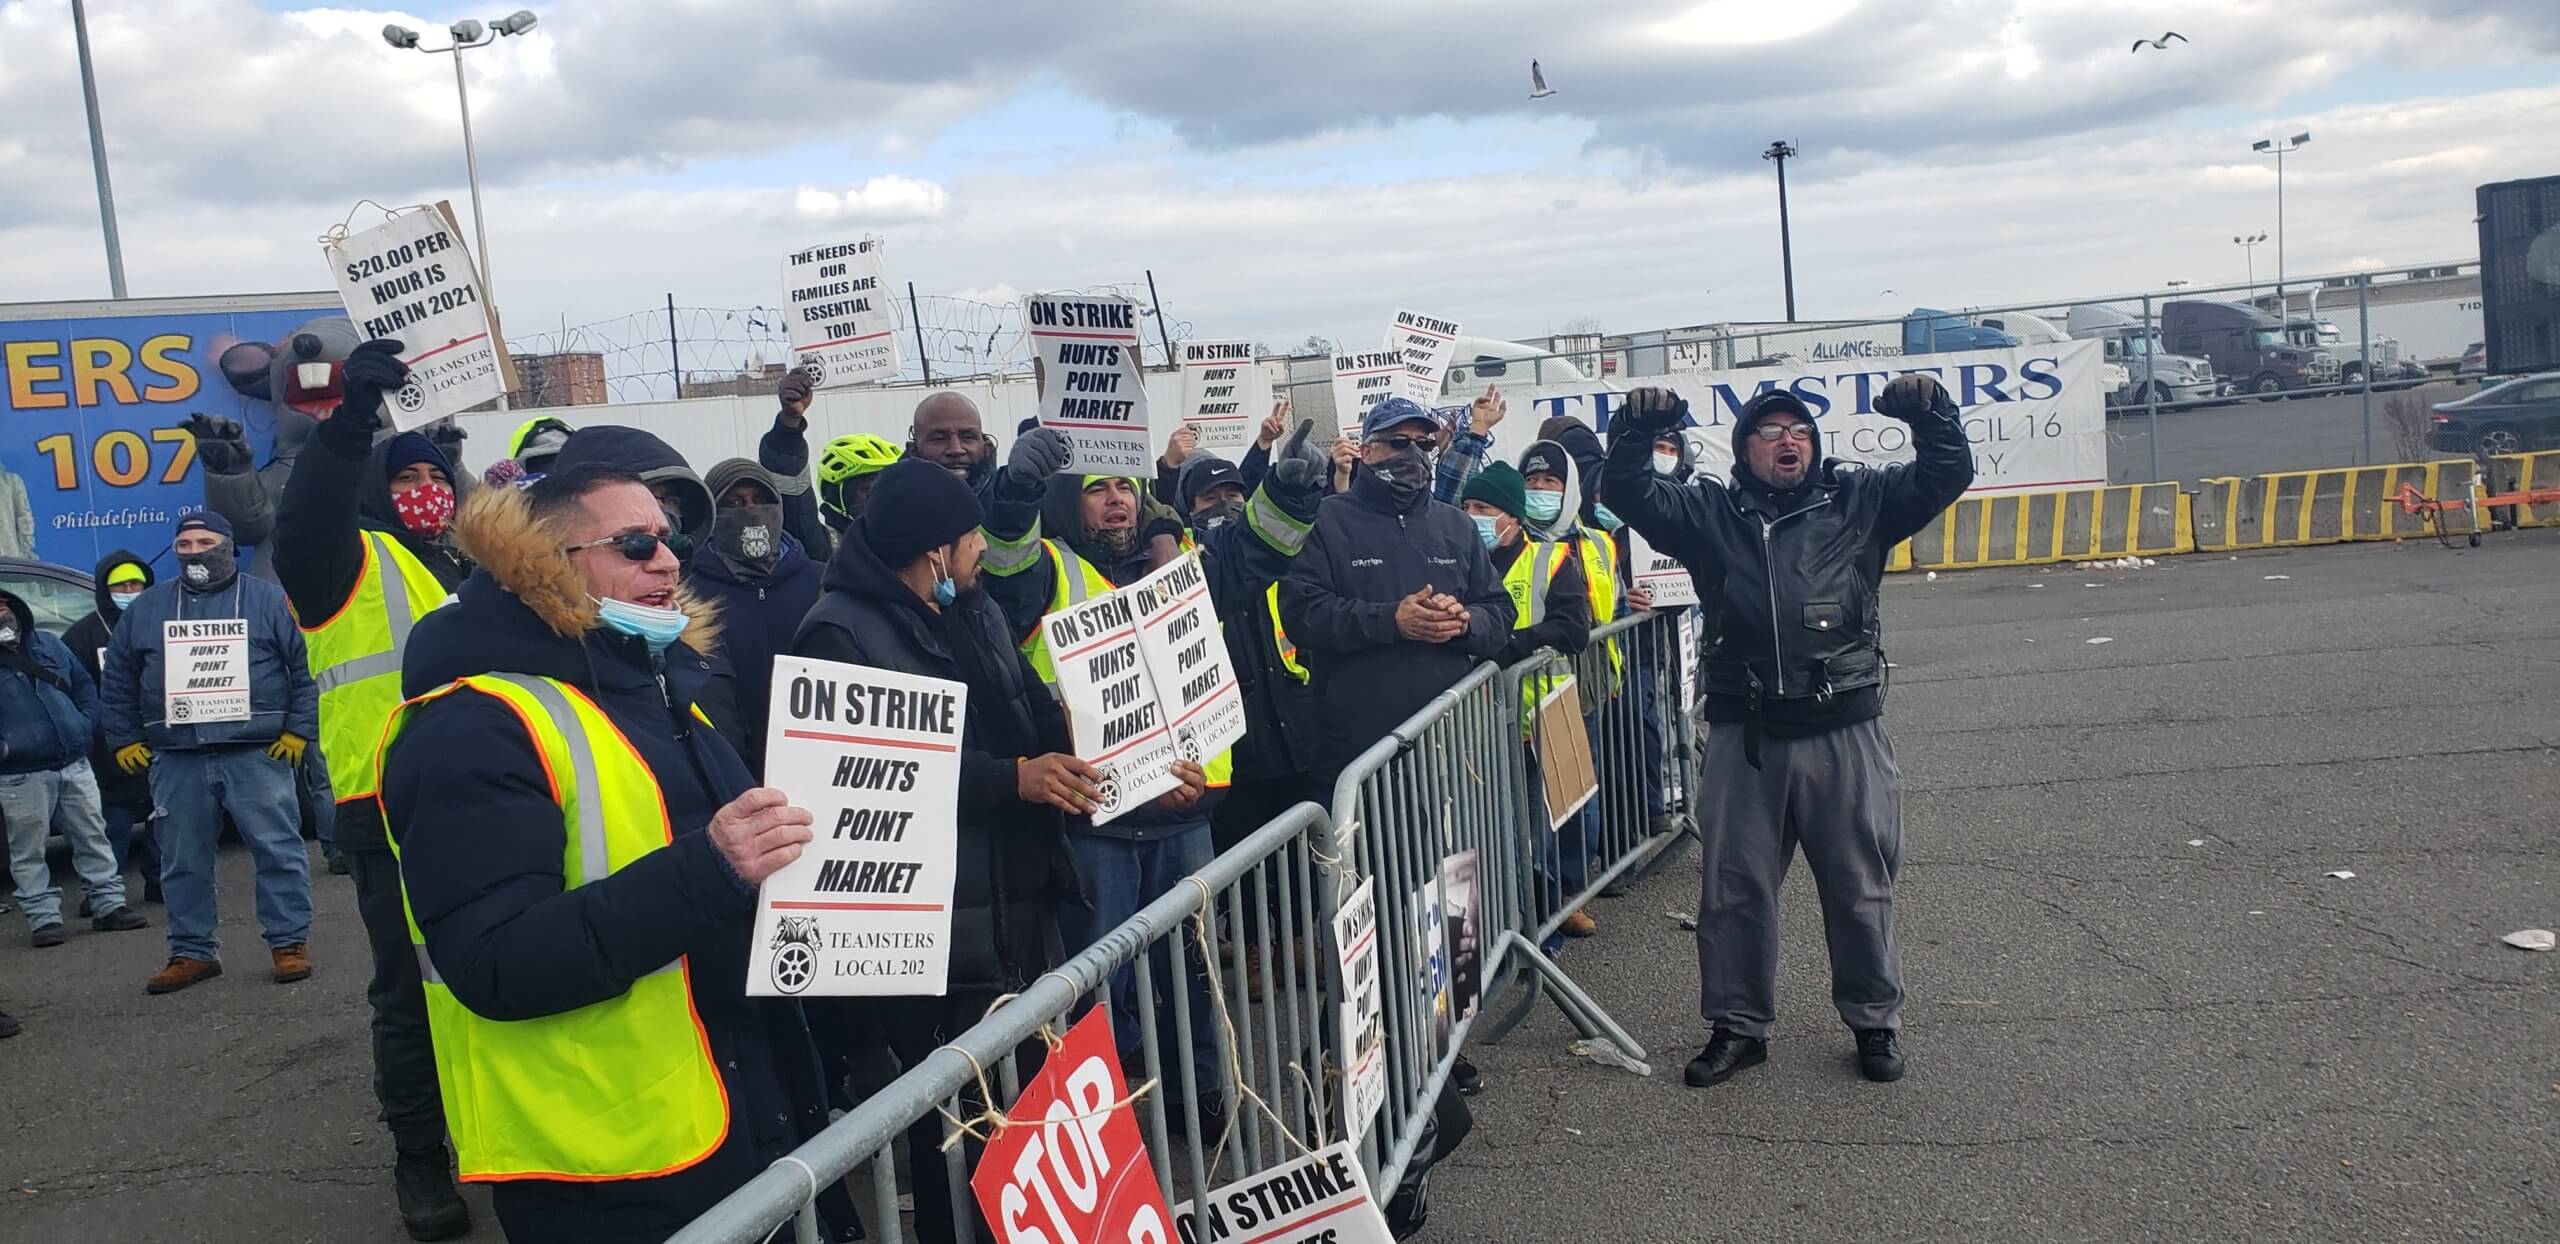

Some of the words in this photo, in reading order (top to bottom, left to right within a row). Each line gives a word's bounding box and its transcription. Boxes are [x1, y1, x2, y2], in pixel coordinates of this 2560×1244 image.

[347, 245, 413, 283] $20.00
[415, 231, 451, 258] PER
[790, 251, 813, 266] THE
[816, 243, 856, 261] NEEDS
[859, 240, 875, 253] OF
[820, 263, 846, 278] OUR
[371, 270, 424, 305] HOUR
[425, 264, 446, 285] IS
[792, 281, 849, 302] FAMILIES
[852, 276, 877, 291] ARE
[364, 310, 406, 339] FAIR
[406, 300, 428, 323] IN
[429, 284, 477, 315] 2021
[803, 297, 871, 322] ESSENTIAL
[1030, 301, 1057, 326] ON
[1061, 302, 1133, 328] STRIKE
[825, 321, 857, 340] TOO!
[1397, 311, 1415, 325] ON
[1415, 316, 1458, 336] STRIKE
[828, 345, 890, 363] TEAMSTERS
[1187, 345, 1204, 360] ON
[1207, 344, 1250, 359] STRIKE
[1406, 334, 1439, 349] HUNTS
[1812, 340, 1873, 359] ALLIANCE
[835, 362, 872, 375] LOCAL
[873, 358, 887, 369] 202
[1059, 343, 1119, 366] HUNTS
[1336, 356, 1354, 371] ON
[1357, 351, 1403, 369] STRIKE
[1403, 348, 1433, 361] POINT
[5, 334, 201, 411] ERS
[433, 370, 476, 393] LOCAL
[478, 362, 495, 377] 202
[1065, 371, 1121, 393] POINT
[1203, 368, 1236, 381] HUNTS
[1357, 375, 1391, 389] HUNTS
[1406, 363, 1432, 376] RKET
[1204, 386, 1235, 398] POINT
[1533, 357, 2063, 434] TEMSTRS
[1059, 398, 1134, 421] MARKET
[1198, 402, 1239, 415] MARKET
[1205, 425, 1245, 433] TEAMSTERS
[1852, 417, 2011, 453] COCIL
[2026, 412, 2062, 439] 16
[1077, 439, 1144, 451] TEAMSTERS
[36, 427, 198, 491] 107
[1084, 454, 1123, 465] LOCAL
[1125, 457, 1141, 466] 202
[53, 508, 170, 529] Philadelphia,
[1651, 559, 1686, 572] MARK
[1658, 581, 1692, 590] TEAMST
[1136, 590, 1157, 617] ON
[168, 625, 188, 638] ON
[193, 623, 244, 636] STRIKE
[1051, 615, 1080, 649] ON
[1078, 595, 1133, 638] STRIK
[1167, 607, 1200, 645] HUNTS
[189, 645, 230, 656] HUNTS
[1088, 642, 1135, 684] HUNTS
[1177, 637, 1207, 674] POINT
[192, 660, 229, 672] POINT
[187, 676, 236, 689] MARKET
[1102, 674, 1141, 714] POINT
[1181, 664, 1221, 708] MARKET
[196, 698, 246, 706] TEAMSTERS
[200, 707, 229, 715] LOCAL
[790, 676, 837, 722] ON
[845, 683, 955, 734] STRIKE
[1102, 701, 1156, 750] MARKET
[1197, 699, 1239, 734] TEAMSTERS
[1204, 723, 1229, 747] LOCAL
[1228, 716, 1240, 731] 202
[1122, 743, 1173, 777] TEAMSTERS
[832, 755, 919, 792] HUNTS
[1127, 766, 1161, 791] LOCAL
[832, 808, 913, 842] POINT
[814, 859, 922, 894] MARKET
[829, 932, 935, 949] TEAMSTERS
[1343, 914, 1352, 951] ON
[834, 959, 898, 976] LOCAL
[899, 959, 925, 976] 202
[1001, 1055, 1115, 1244] STOP
[1228, 1152, 1356, 1230] STRIKE
